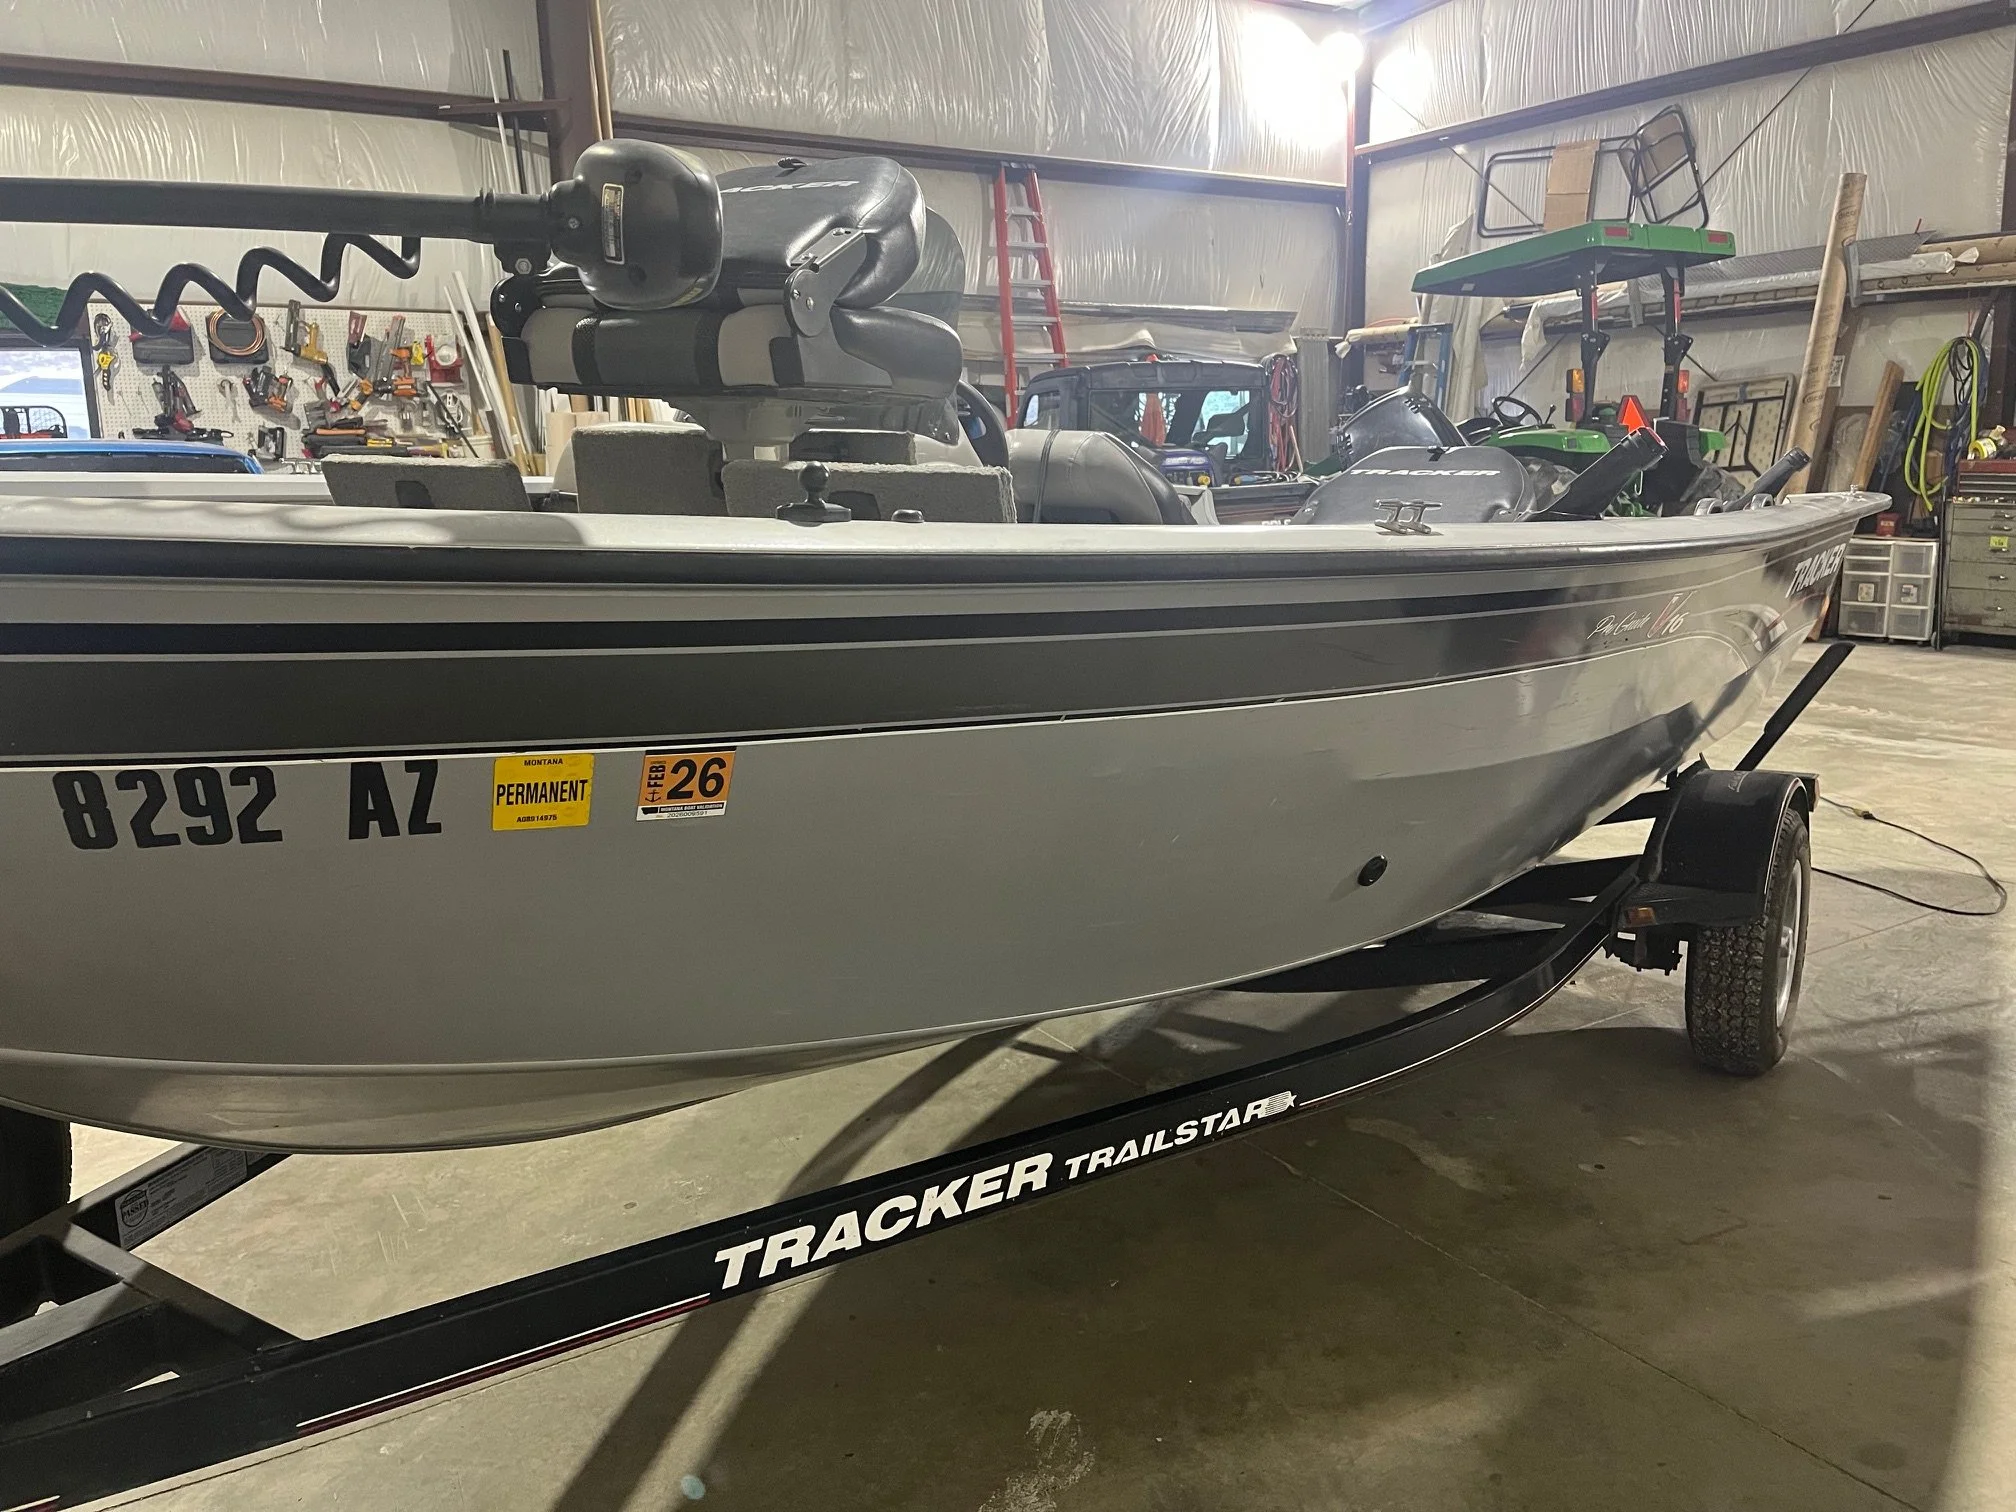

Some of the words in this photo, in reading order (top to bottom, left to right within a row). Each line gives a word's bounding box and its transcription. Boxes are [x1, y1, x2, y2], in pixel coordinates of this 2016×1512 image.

[720, 181, 860, 194] ACKER
[1785, 543, 1847, 598] TRACKER
[524, 758, 563, 767] MONTANA
[647, 764, 667, 788] FEB
[667, 757, 727, 800] 26
[52, 765, 283, 850] 8292
[349, 759, 442, 840] AZ
[496, 779, 588, 806] PERMANENT
[715, 1152, 1053, 1290] TRACKER
[1065, 1099, 1269, 1179] TRAILSTAR
